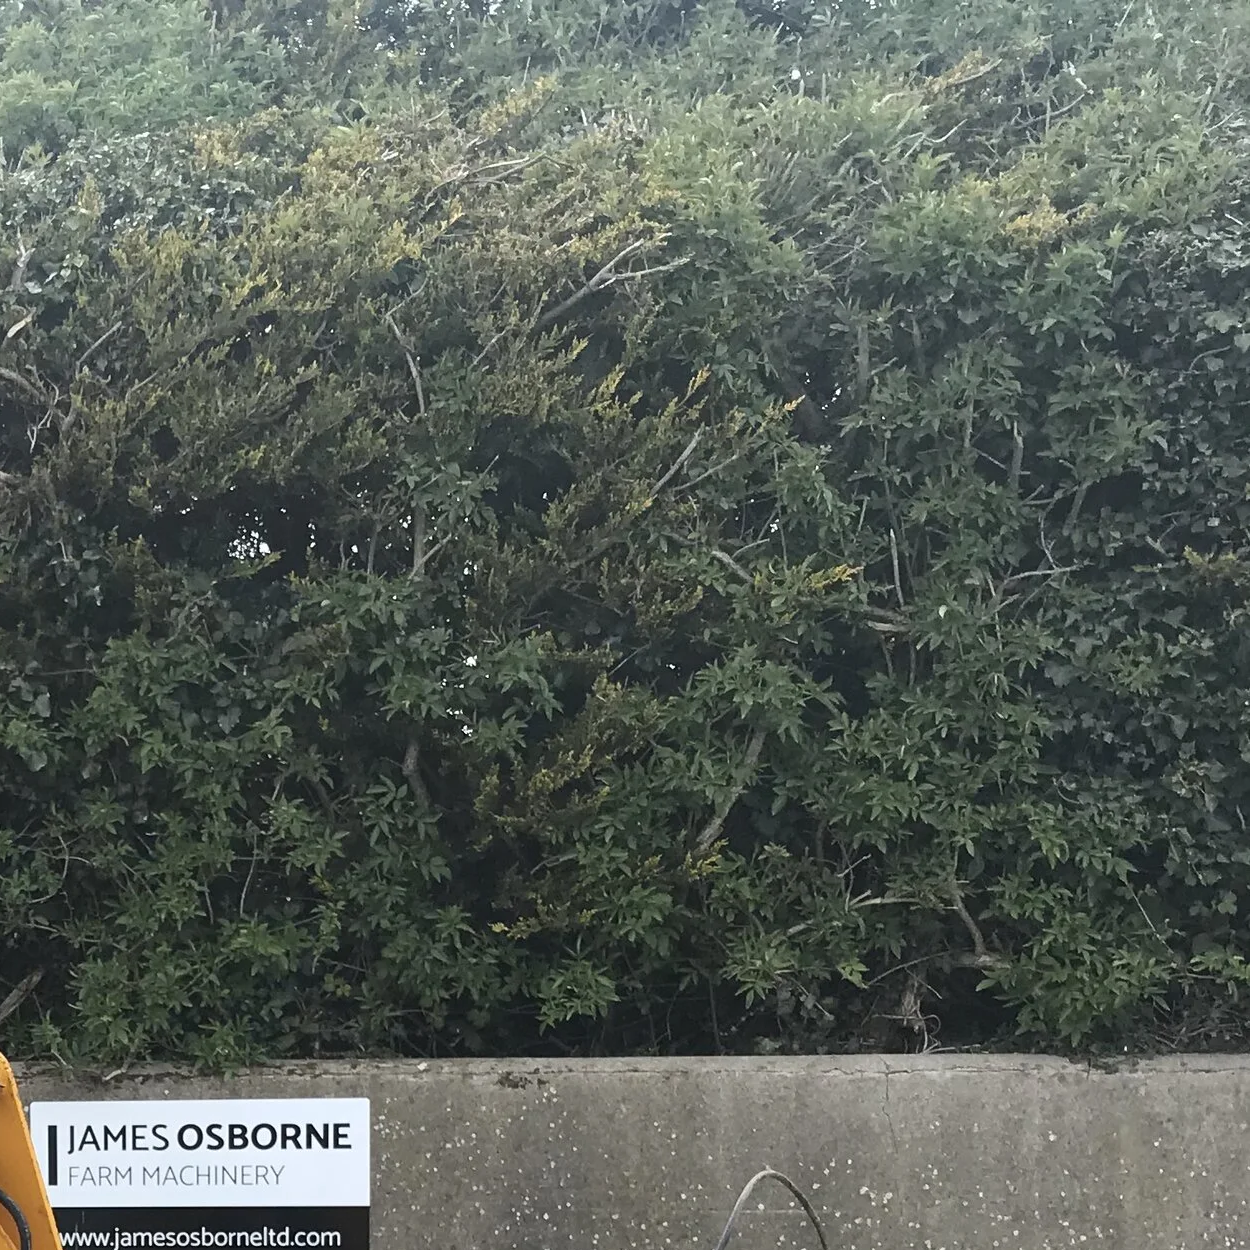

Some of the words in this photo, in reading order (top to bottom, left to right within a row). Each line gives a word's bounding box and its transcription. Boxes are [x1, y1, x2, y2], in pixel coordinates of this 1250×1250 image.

[67, 1124, 170, 1155] JAMES
[177, 1123, 352, 1151] OSBORNE
[68, 1166, 133, 1187] FARM
[142, 1164, 285, 1187] MACHINERY
